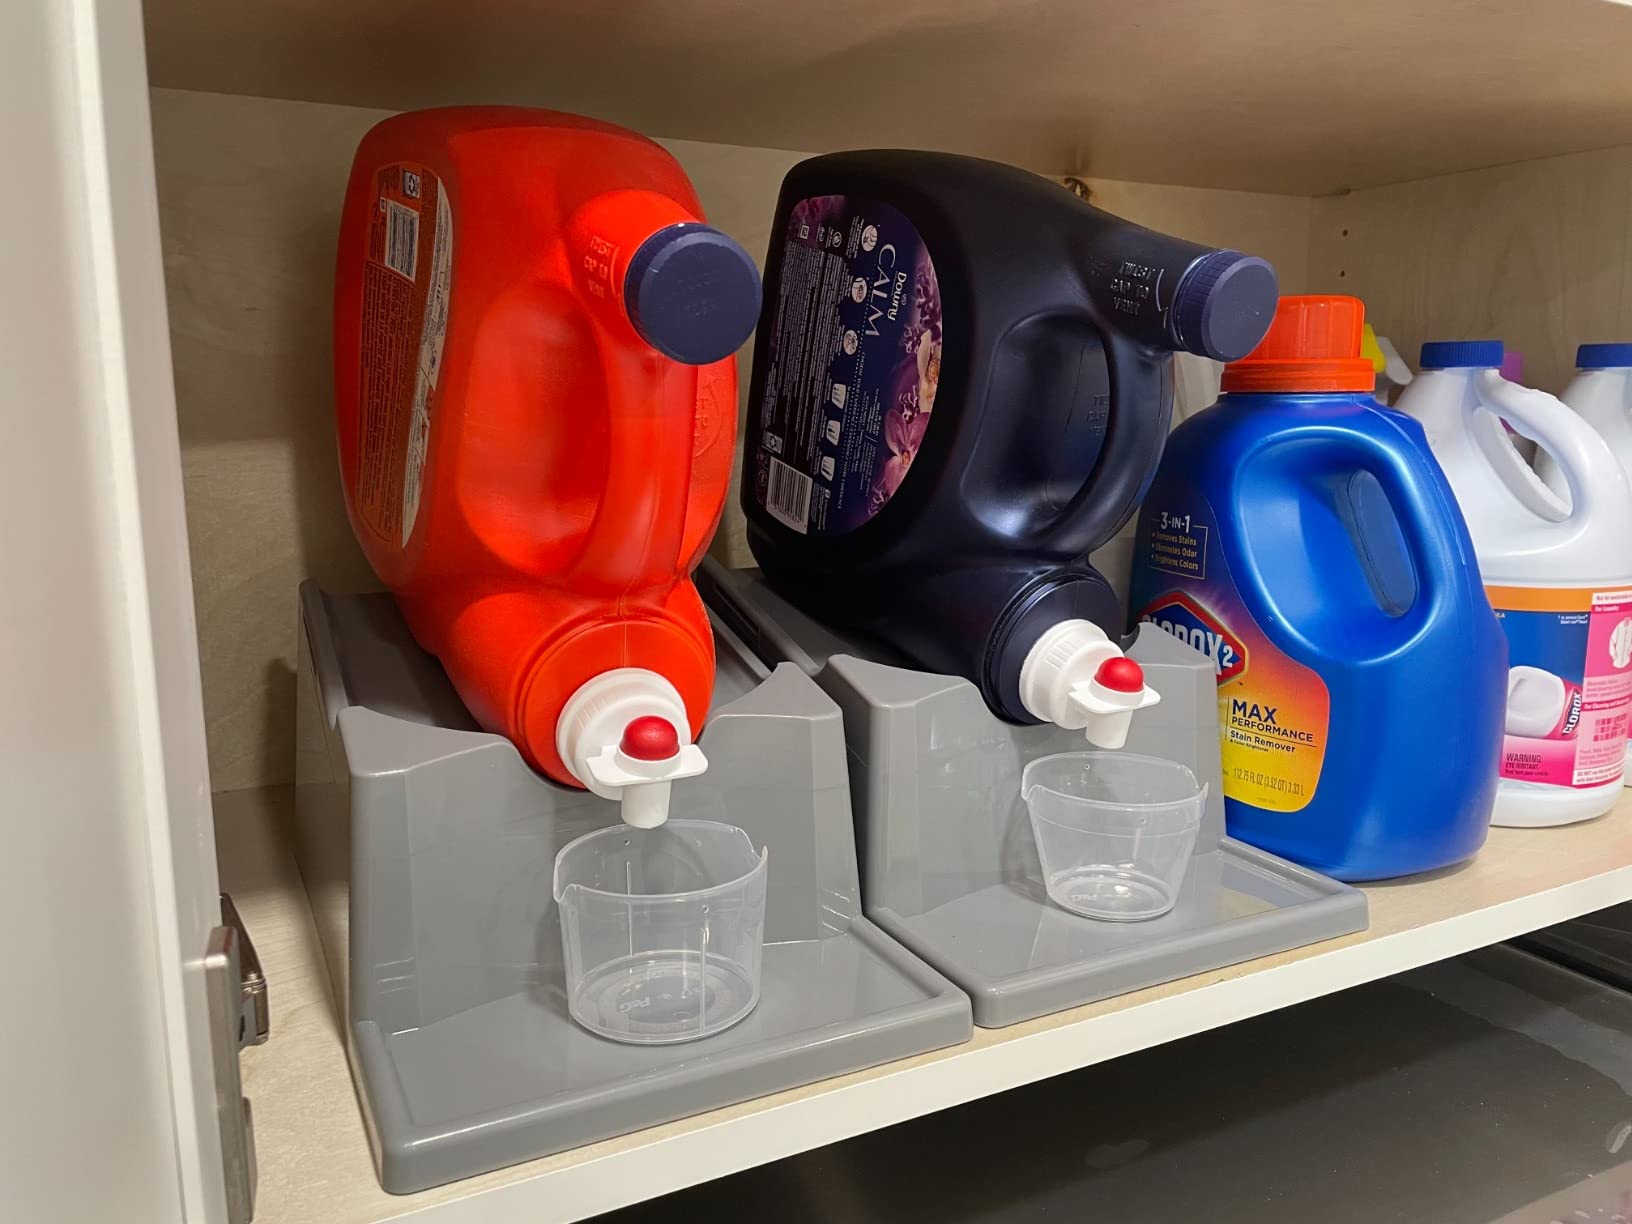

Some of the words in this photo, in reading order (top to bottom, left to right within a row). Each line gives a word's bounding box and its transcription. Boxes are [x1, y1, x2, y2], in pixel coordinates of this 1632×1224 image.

[865, 243, 896, 336] CALM
[887, 271, 907, 321] Downy
[1160, 511, 1190, 534] 3-IN-1
[1179, 534, 1197, 546] Stains
[1182, 547, 1198, 558] Odor
[1179, 559, 1199, 570] Colors
[1232, 698, 1278, 725] MAX
[1562, 692, 1582, 735] CLOROX
[1231, 715, 1314, 743] PERFORMANCE
[1230, 730, 1252, 743] Stain
[1254, 736, 1296, 753] Remover
[1233, 767, 1249, 781] 112.75
[1249, 771, 1256, 784] FL
[1256, 773, 1264, 786] OZ
